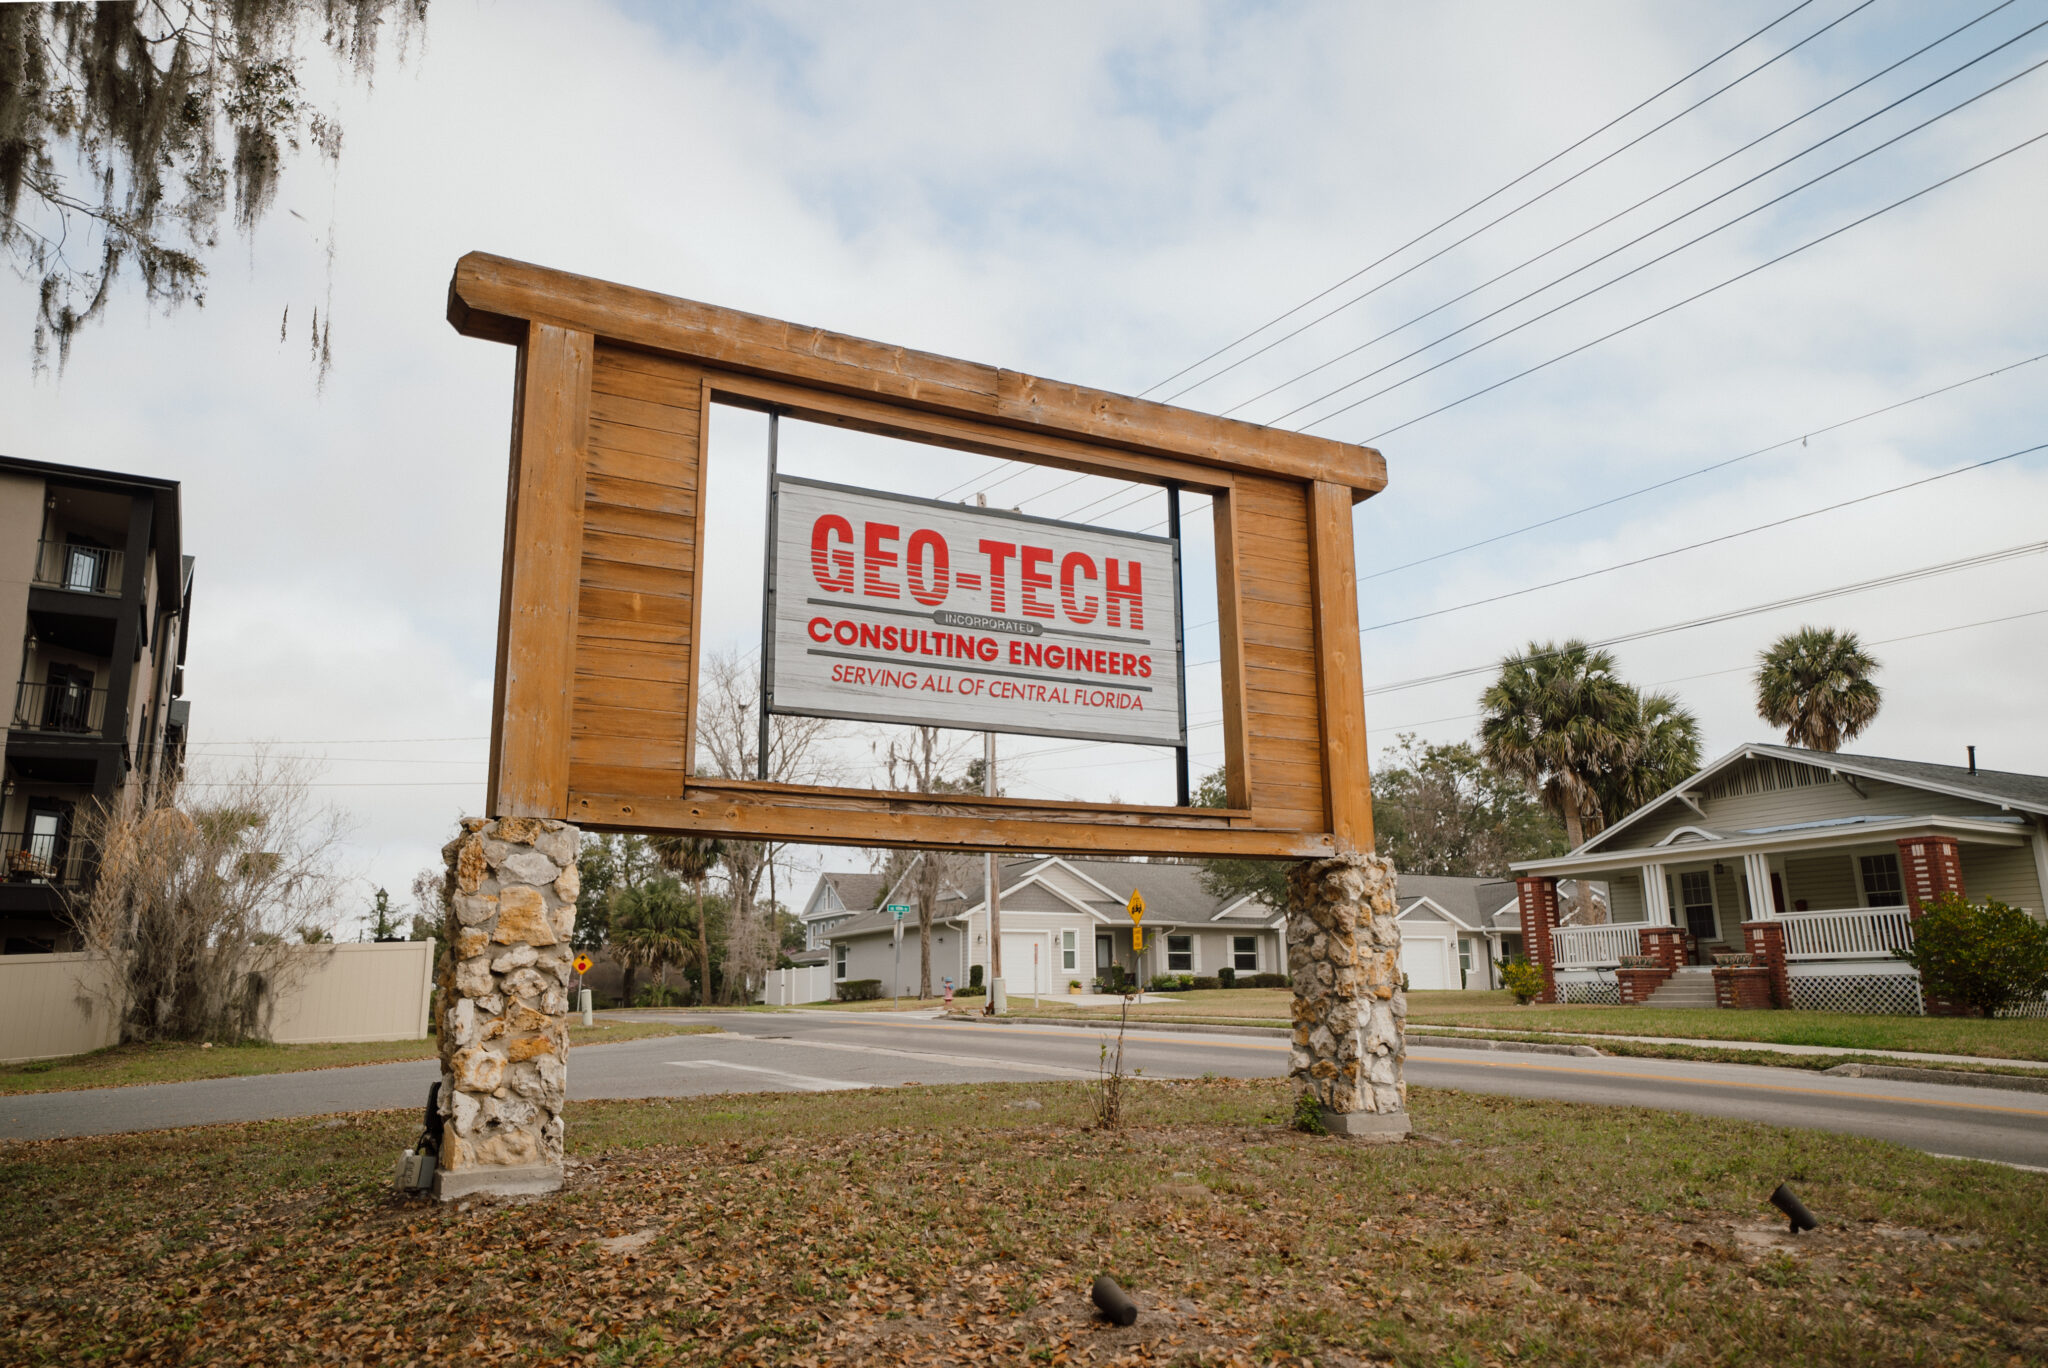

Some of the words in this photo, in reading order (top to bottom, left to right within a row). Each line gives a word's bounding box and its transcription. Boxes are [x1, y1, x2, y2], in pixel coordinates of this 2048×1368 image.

[810, 513, 1145, 631] GEO-TECH
[807, 616, 1000, 662] CONSULTING
[1009, 639, 1153, 678] ENGINEERS
[944, 612, 1035, 634] INCORPORATED
[831, 663, 918, 689] SERVING
[921, 674, 954, 694] ALL
[957, 677, 985, 695] OF
[988, 680, 1070, 704] CENTRAL
[1074, 688, 1144, 711] FLORIDA
